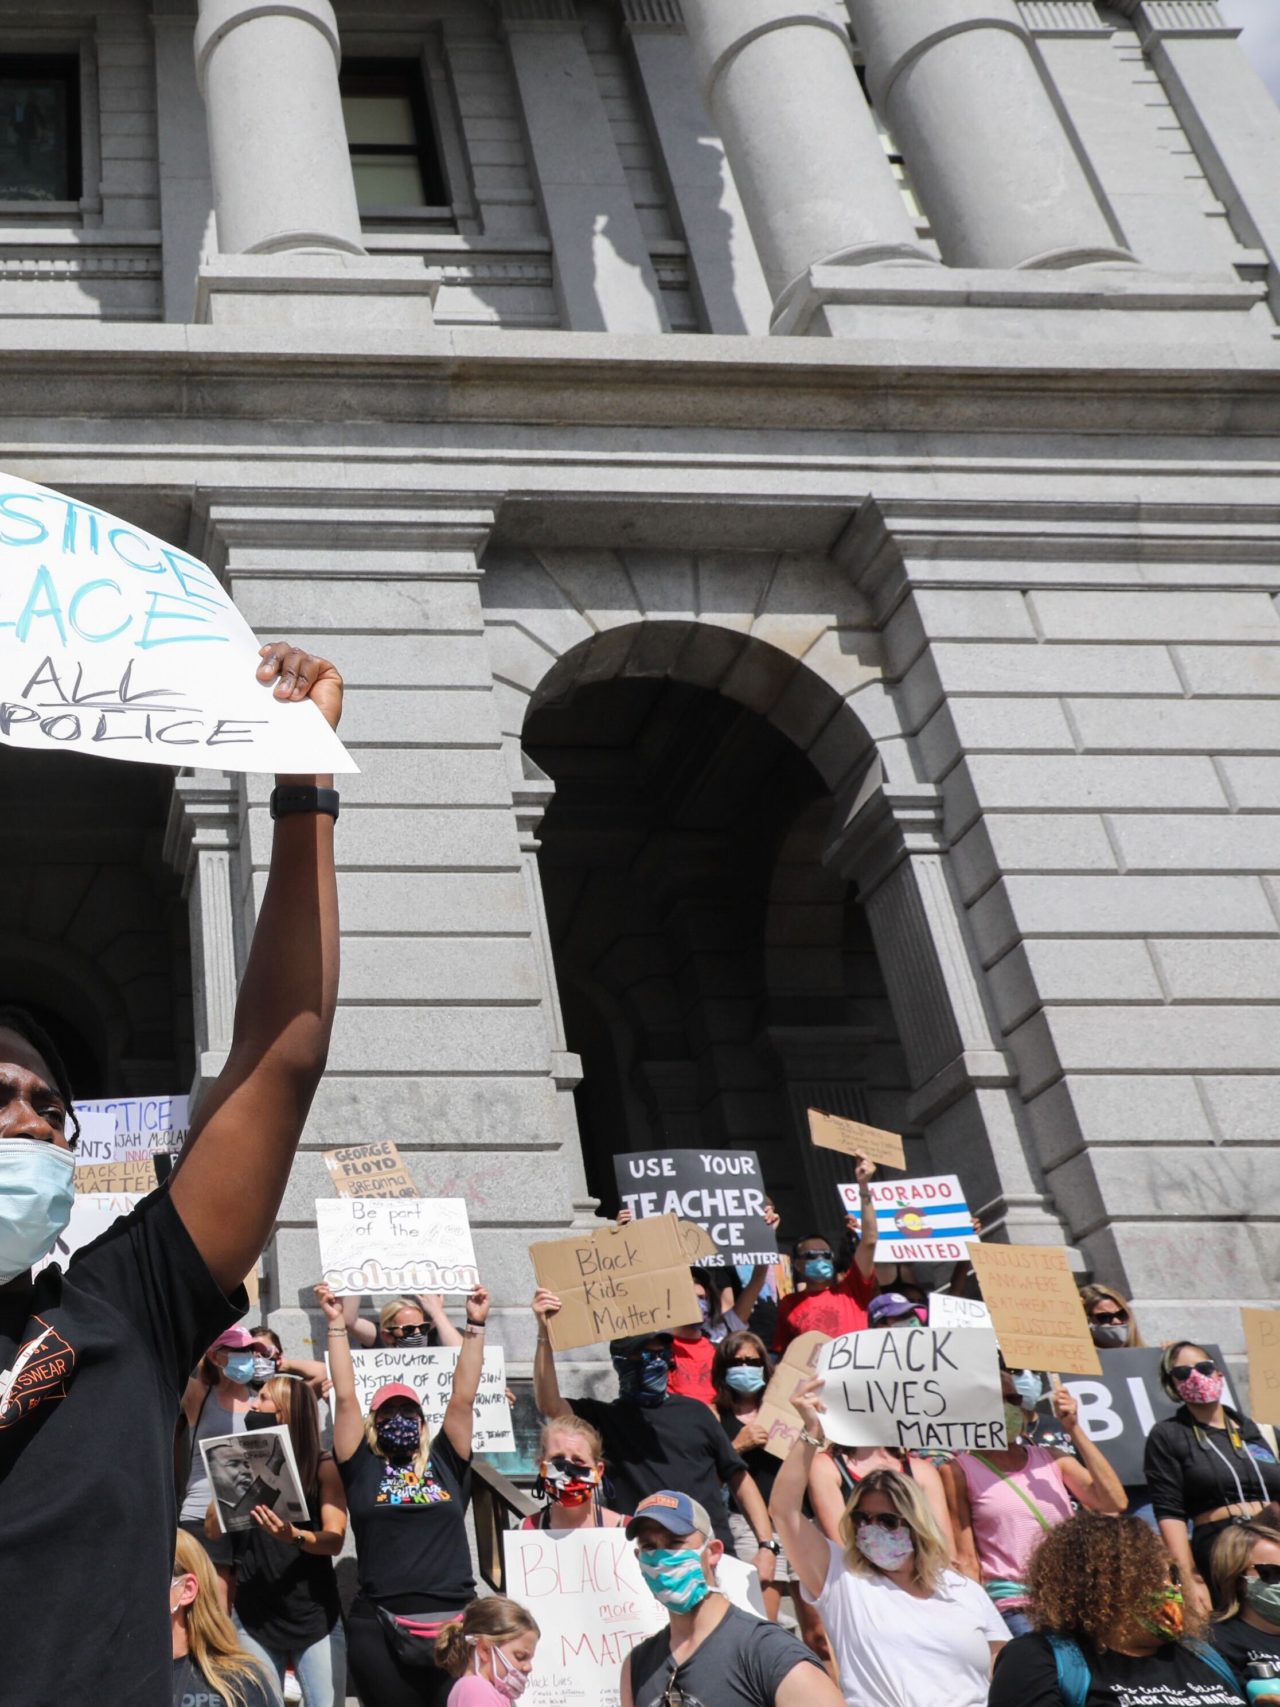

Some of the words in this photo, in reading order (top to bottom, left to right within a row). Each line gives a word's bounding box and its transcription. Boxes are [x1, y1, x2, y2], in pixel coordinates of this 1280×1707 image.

[20, 655, 188, 704] ALL
[334, 1142, 392, 1162] GEORGE
[124, 1162, 151, 1176] LIVE
[342, 1157, 396, 1176] FLOYD
[629, 1157, 677, 1178] USE
[699, 1154, 756, 1175] YOUR
[844, 1182, 952, 1202] CLORADO
[352, 1202, 377, 1220] Be
[388, 1204, 422, 1225] part
[622, 1188, 766, 1222] TEACHER
[355, 1222, 375, 1237] of
[391, 1223, 420, 1238] the
[575, 1241, 644, 1276] Black
[732, 1252, 780, 1265] MATTER
[890, 1243, 961, 1260] UNITED
[326, 1262, 477, 1290] solution
[583, 1279, 630, 1305] Kids
[942, 1297, 986, 1319] END
[375, 1353, 440, 1368] EDUCATOR
[827, 1329, 960, 1373] BLACK
[413, 1373, 430, 1387] OF
[842, 1380, 948, 1418] LIVES
[897, 1420, 1008, 1450] MATTER
[520, 1542, 638, 1598] BLACK
[600, 1600, 640, 1618] more
